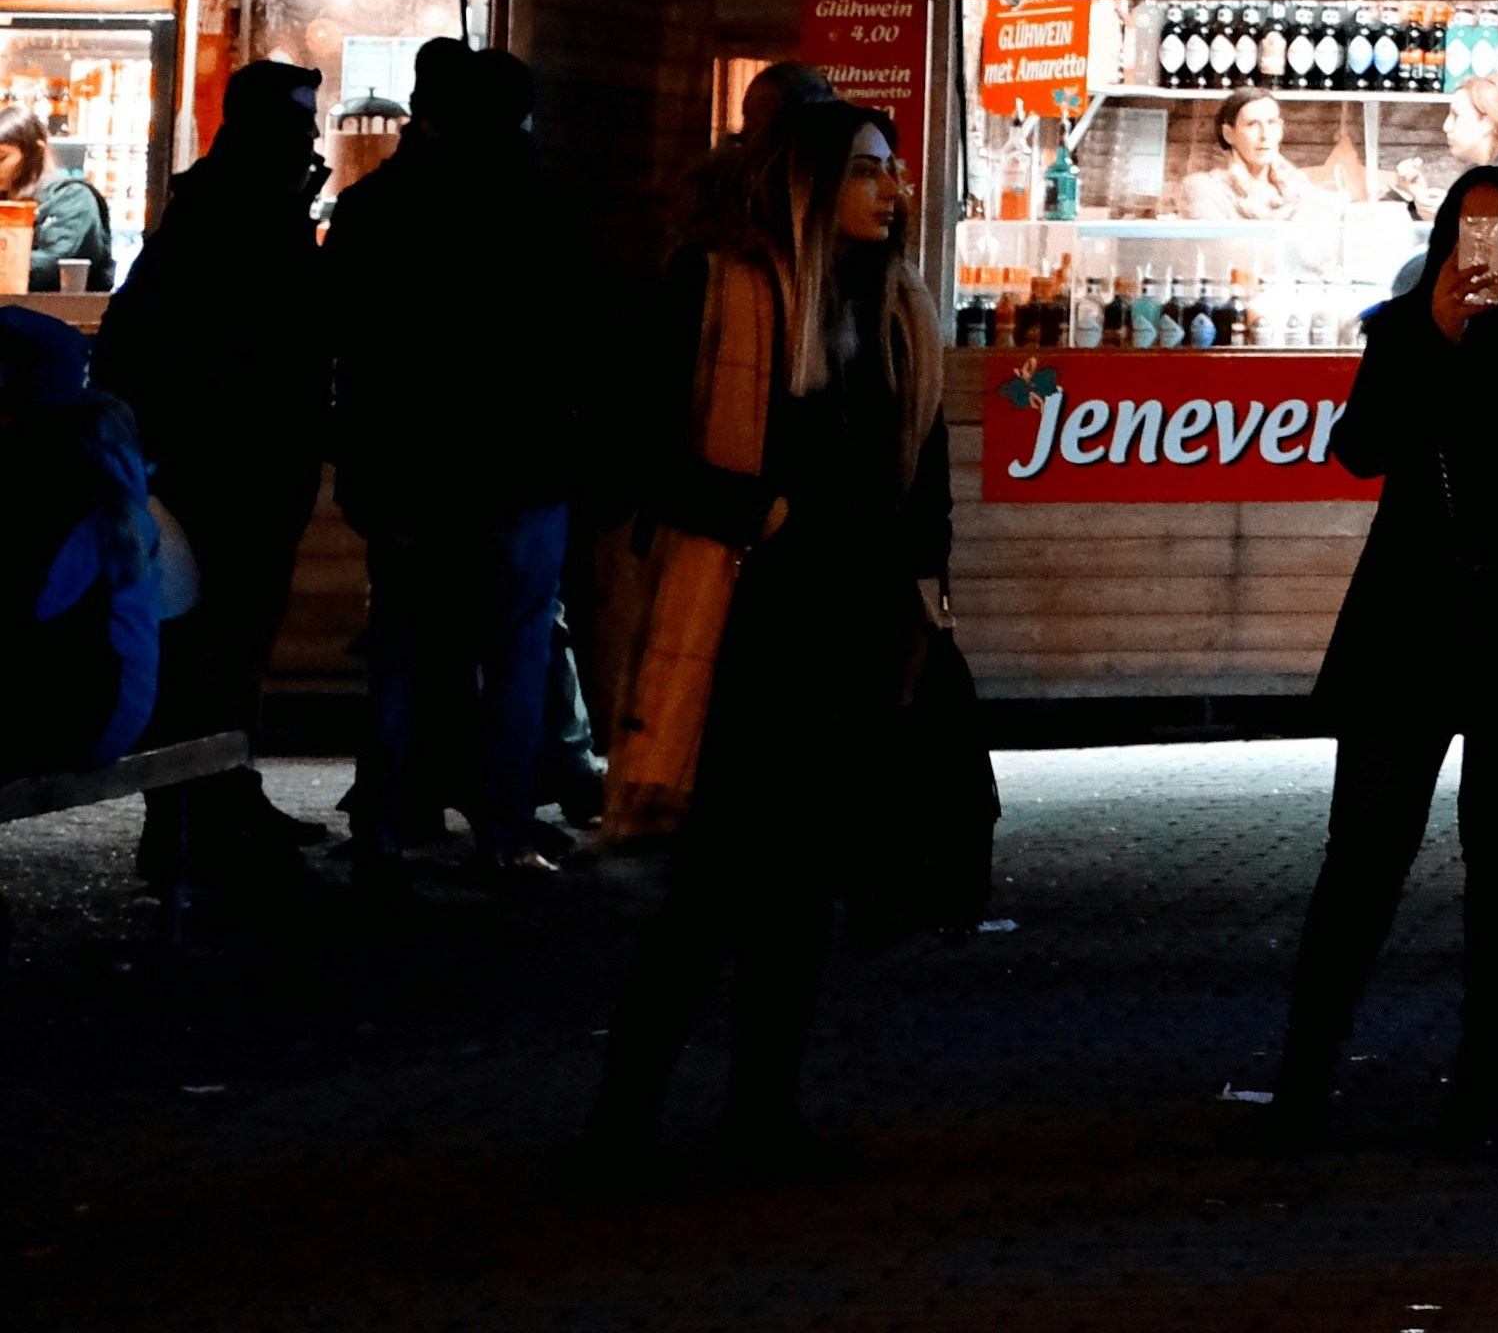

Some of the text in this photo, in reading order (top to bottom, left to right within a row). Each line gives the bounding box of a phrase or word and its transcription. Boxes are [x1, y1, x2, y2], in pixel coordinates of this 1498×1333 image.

[815, 0, 913, 18] Glühwein
[850, 24, 901, 45] 4,00
[998, 20, 1074, 51] GLÜHWEIN
[984, 53, 1087, 88] met Amaretto
[1008, 386, 1347, 478] Jenever
